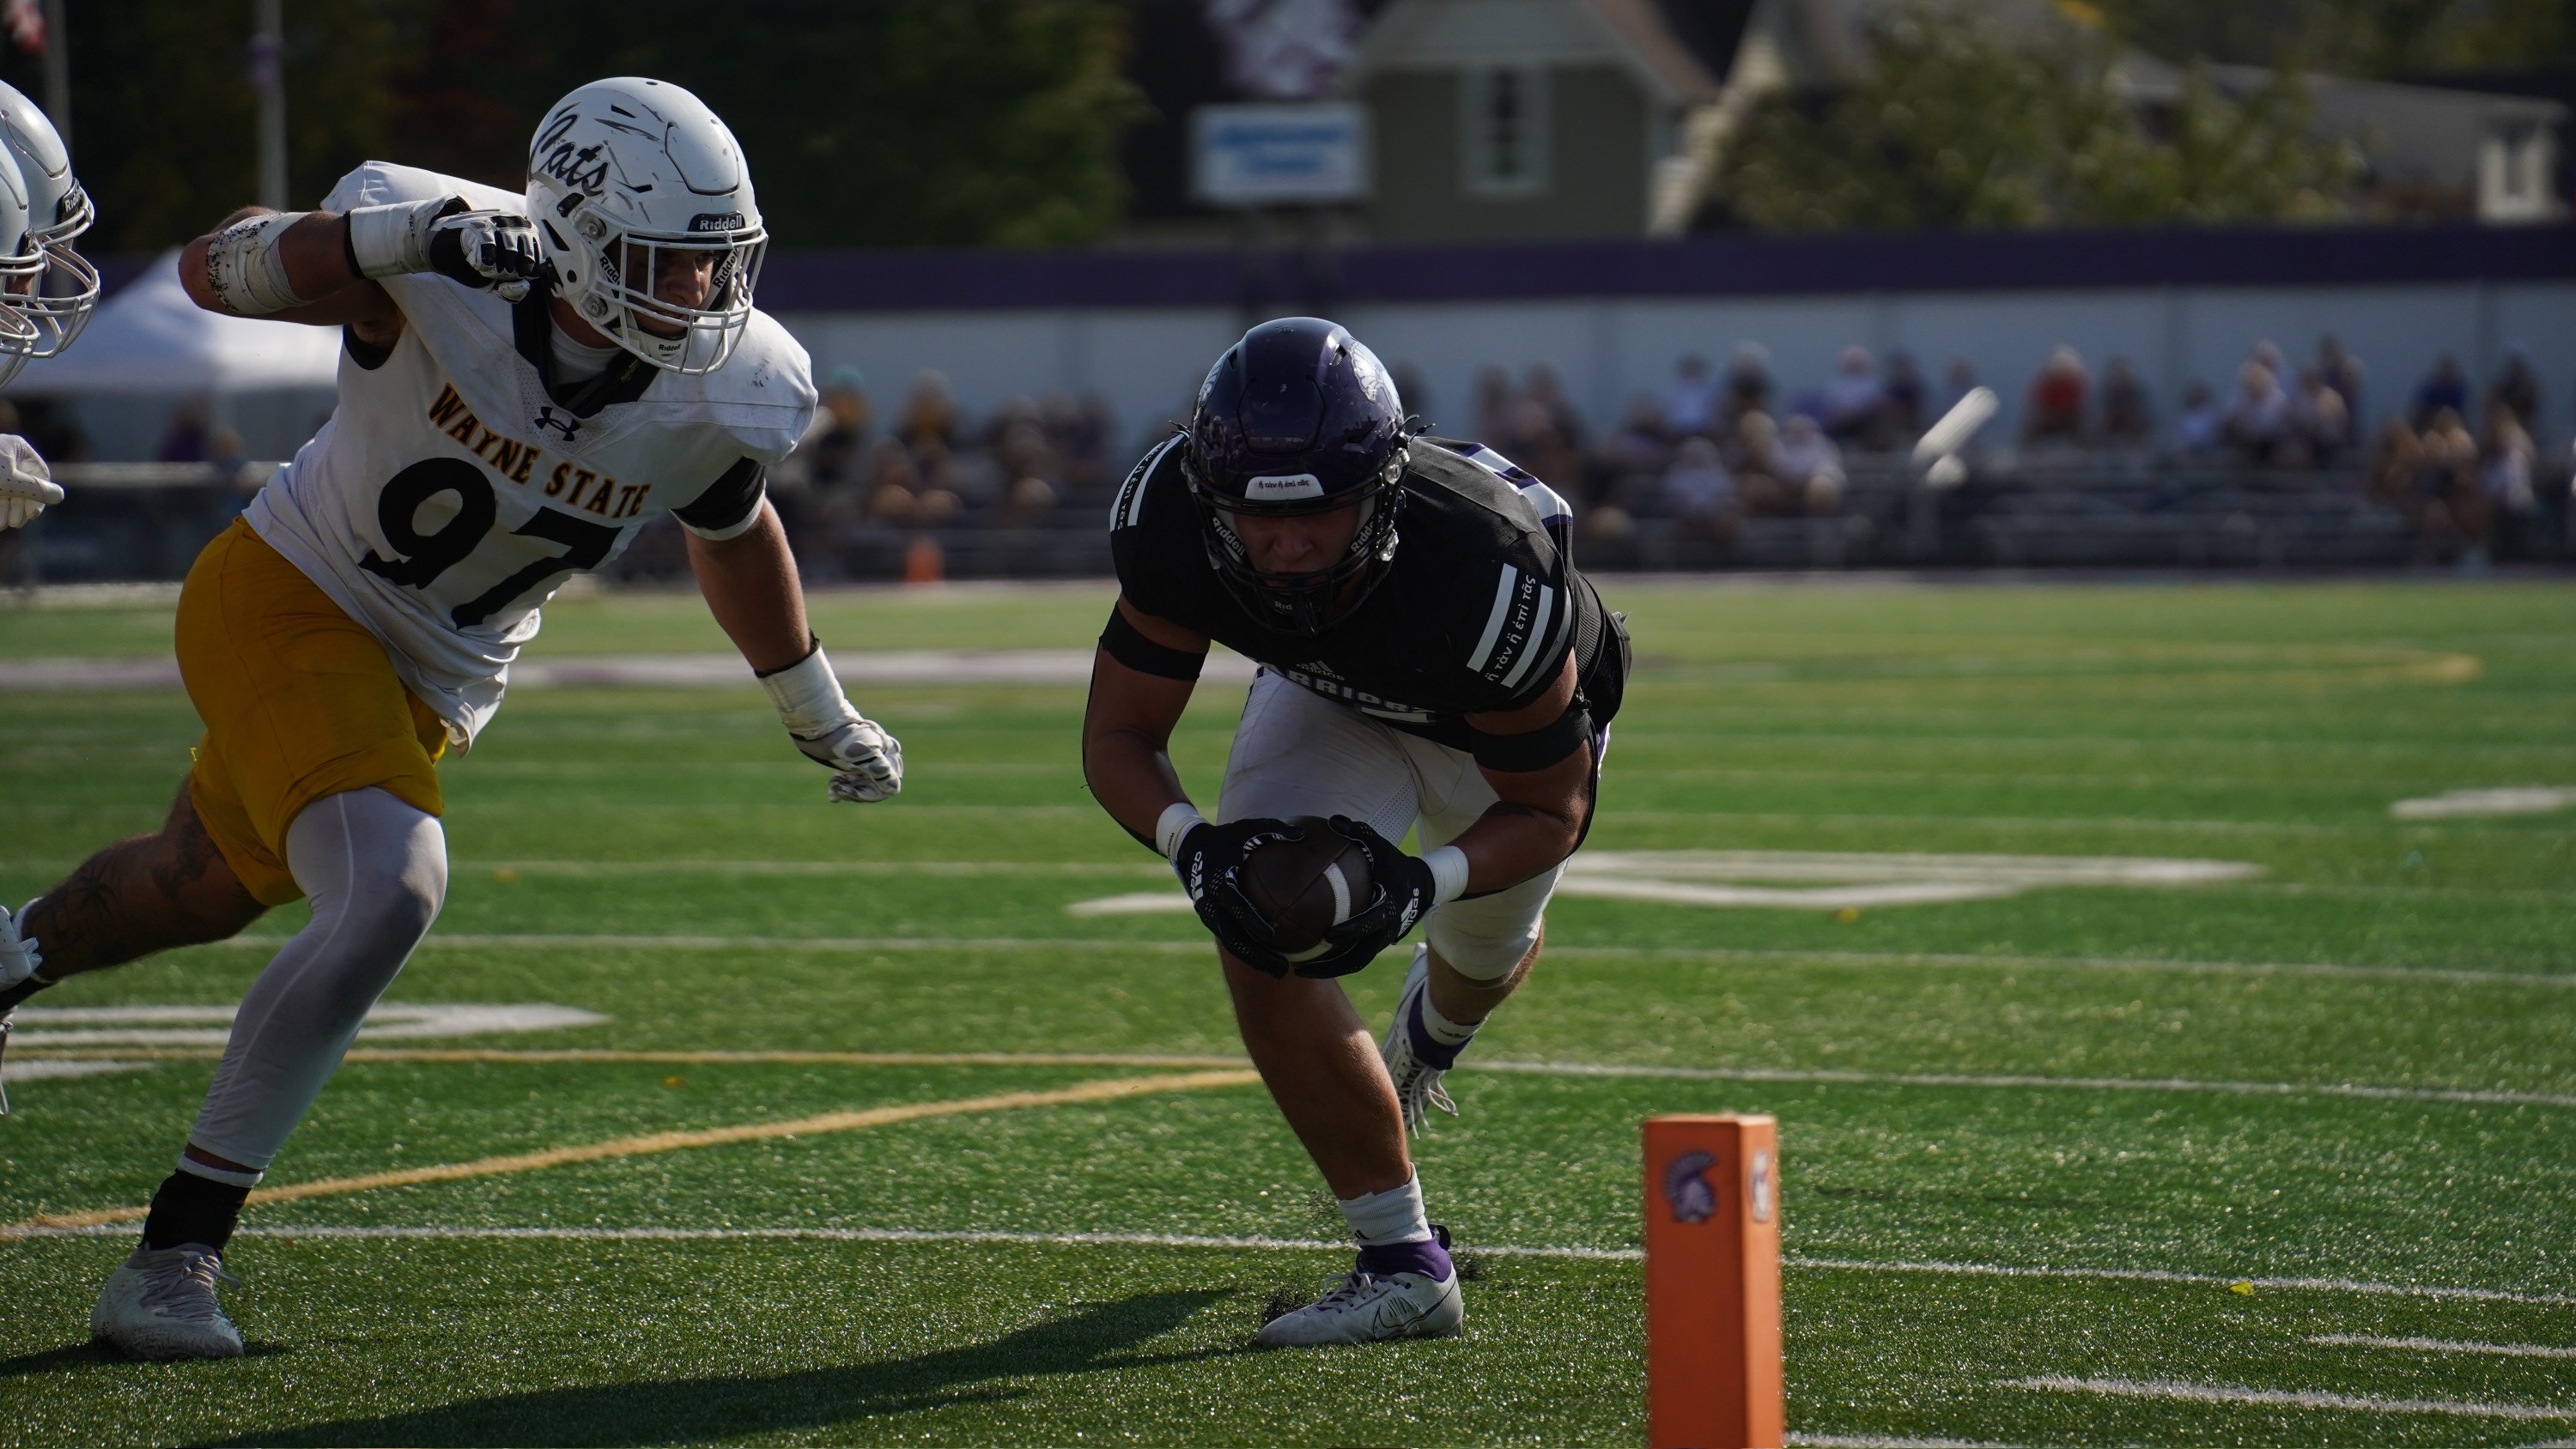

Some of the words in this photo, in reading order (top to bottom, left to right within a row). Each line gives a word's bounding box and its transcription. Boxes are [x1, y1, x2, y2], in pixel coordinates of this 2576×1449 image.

[699, 215, 743, 230] Riddell
[599, 256, 620, 286] Ridd
[428, 383, 541, 486] WAYNE
[544, 460, 652, 518] STATE
[357, 458, 625, 631] 97
